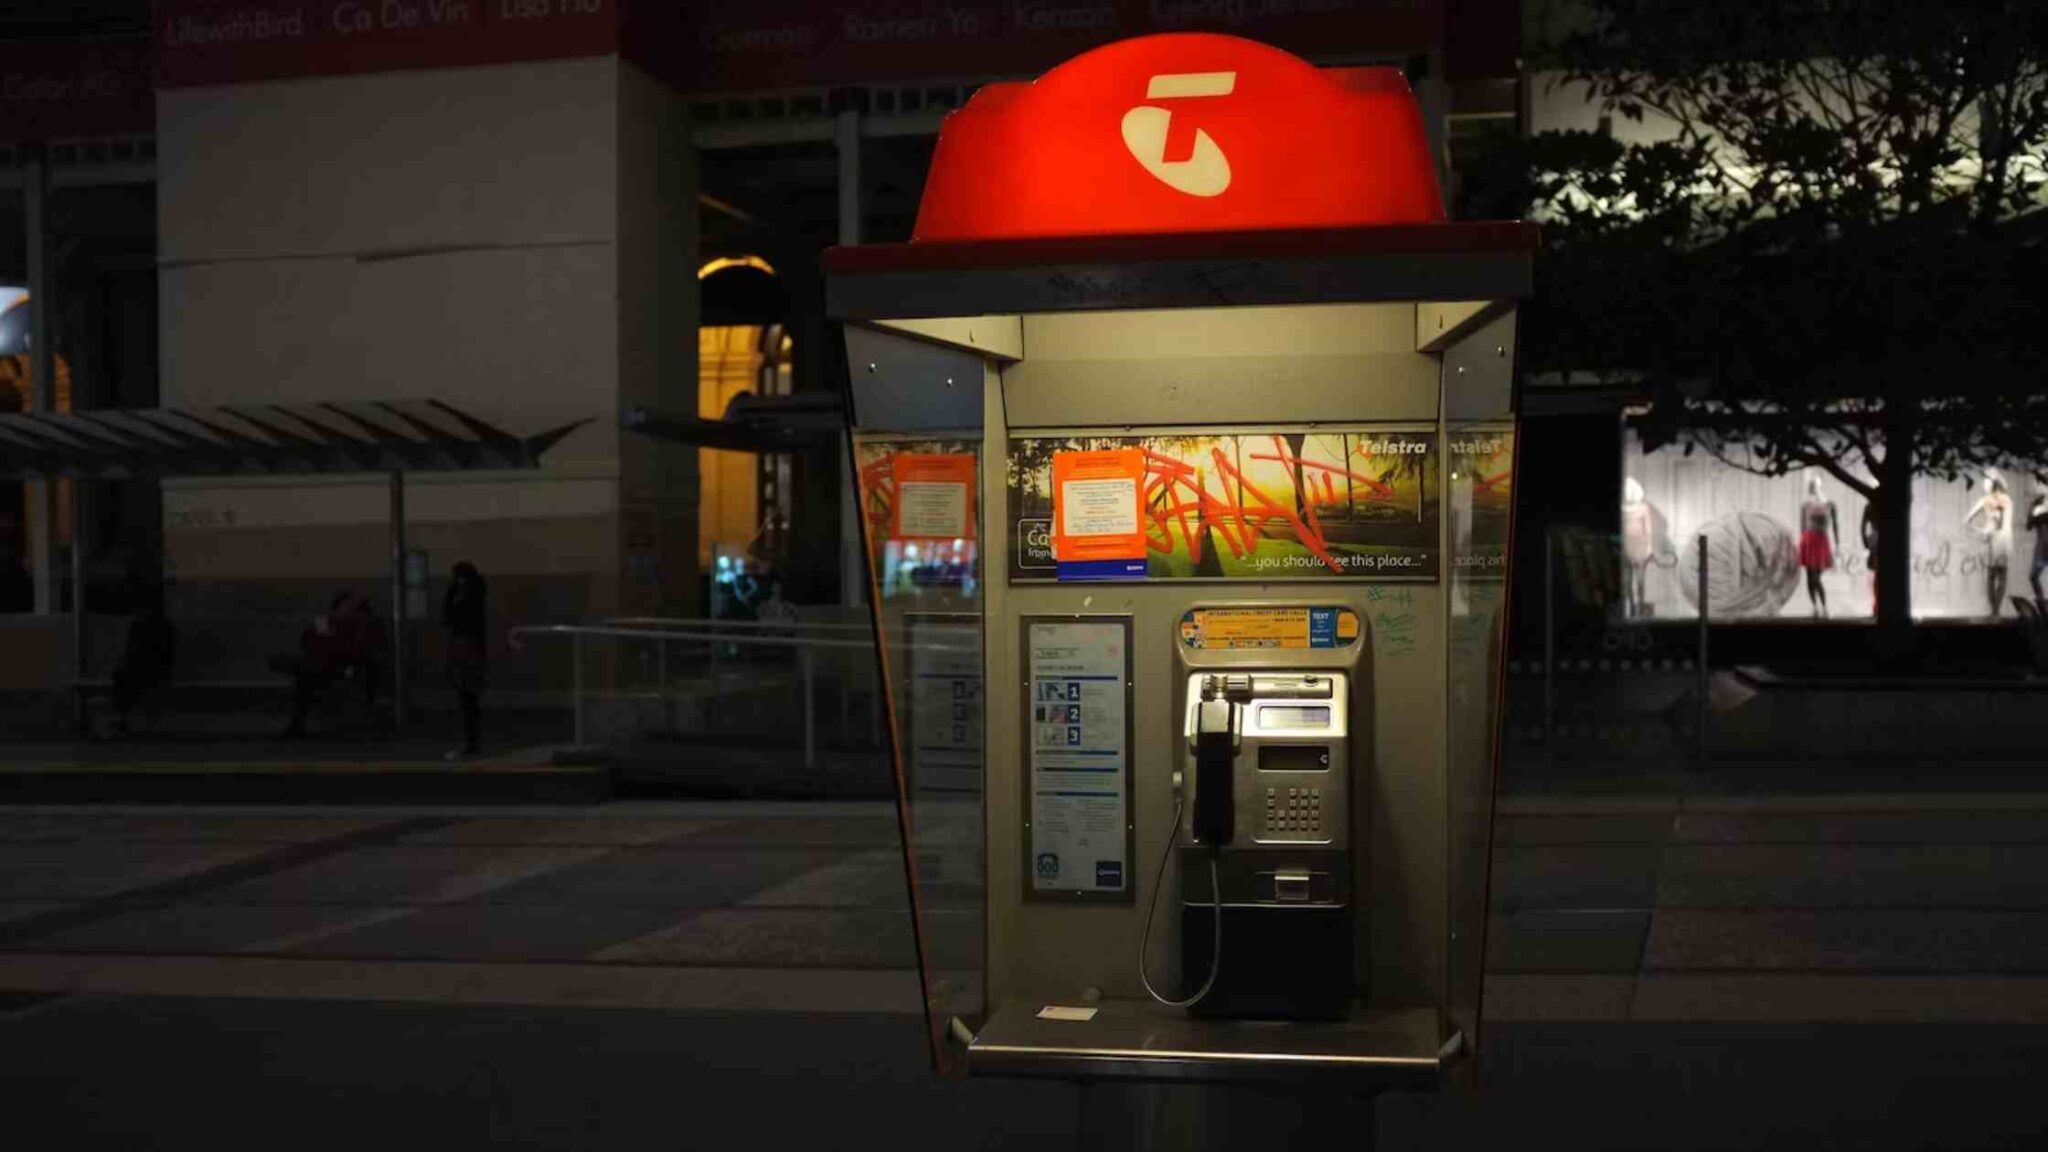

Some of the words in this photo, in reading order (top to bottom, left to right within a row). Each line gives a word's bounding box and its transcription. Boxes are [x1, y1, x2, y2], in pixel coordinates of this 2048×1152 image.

[381, 0, 418, 28] De
[1359, 439, 1427, 454] Telstra
[1351, 554, 1375, 567] this
[1312, 612, 1330, 620] TEXT
[1070, 687, 1078, 697] 1
[1070, 708, 1079, 719] 2
[1070, 730, 1078, 741] 3
